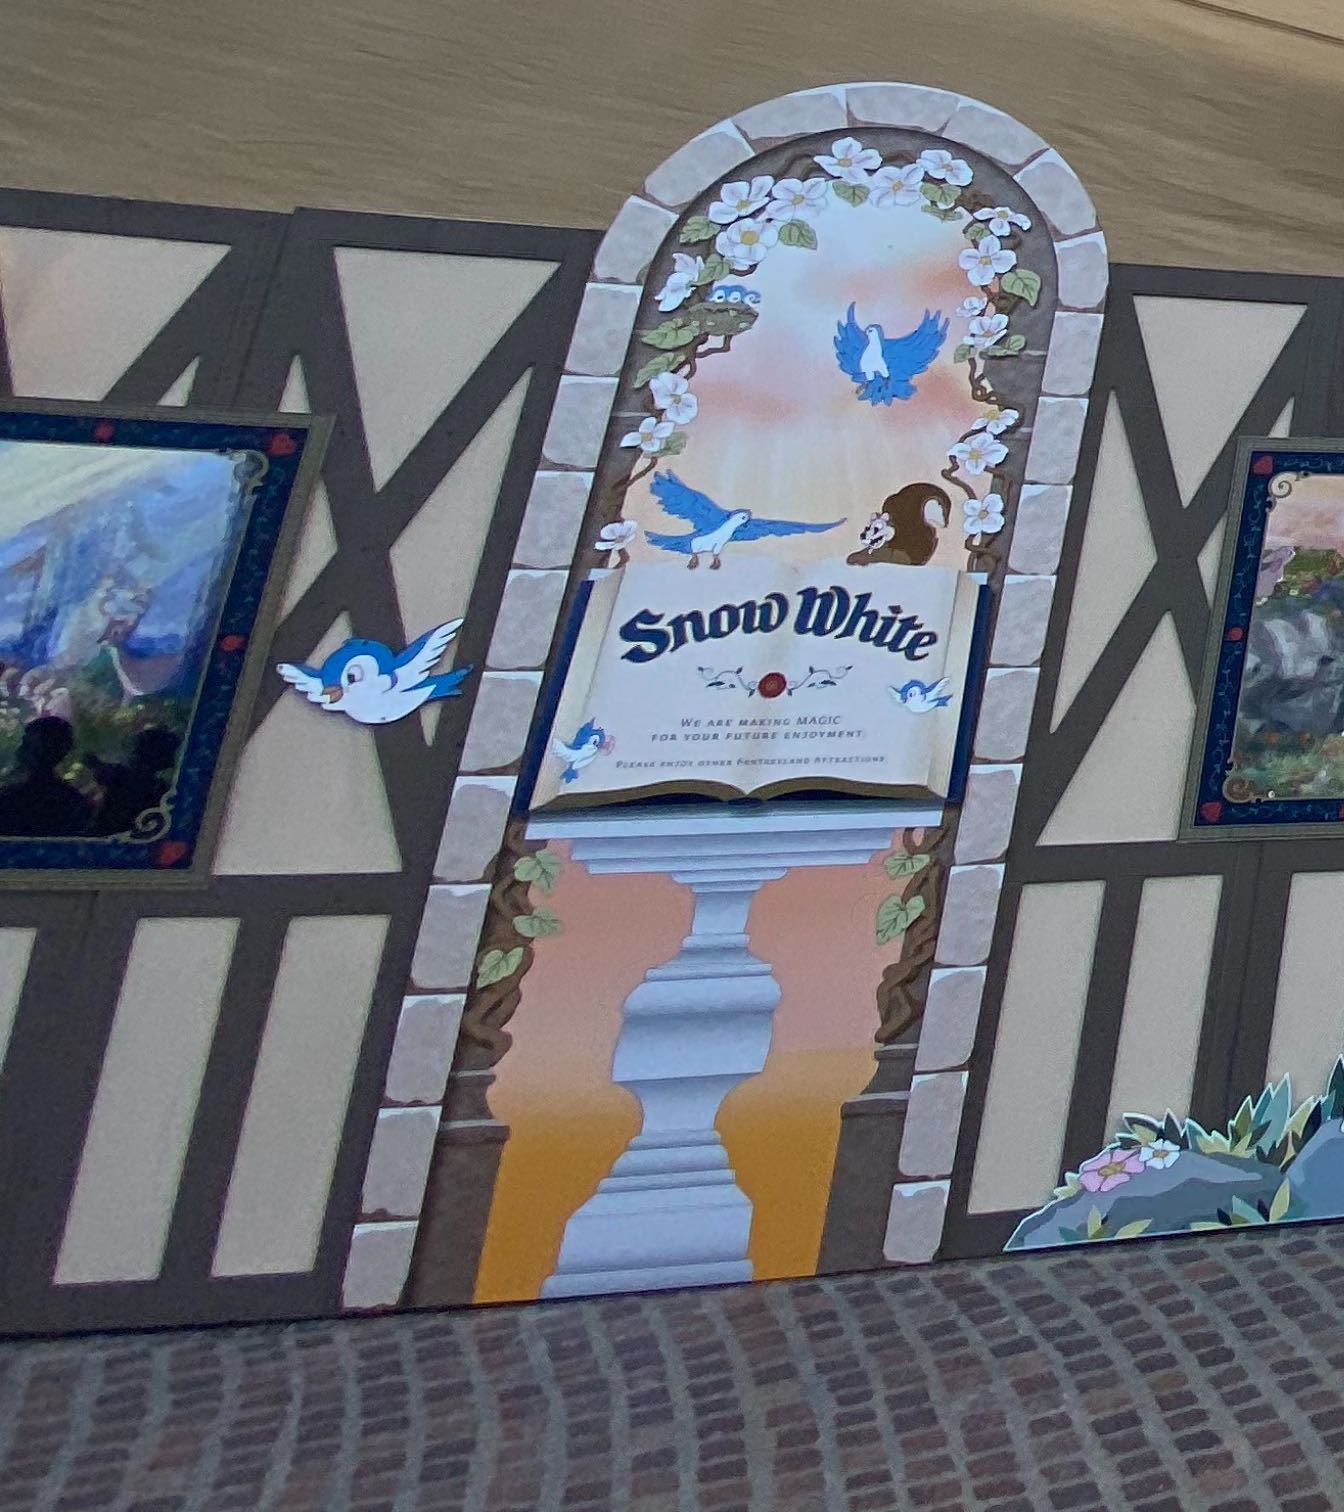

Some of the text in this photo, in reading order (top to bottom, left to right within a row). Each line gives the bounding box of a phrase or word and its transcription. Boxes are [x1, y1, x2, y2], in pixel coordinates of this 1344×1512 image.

[619, 585, 939, 663] Snow White
[738, 717, 791, 727] MAKING
[796, 715, 842, 726] MAGIC
[651, 732, 678, 743] FOR
[684, 732, 720, 742] YOUR
[725, 731, 778, 741] FUTURE
